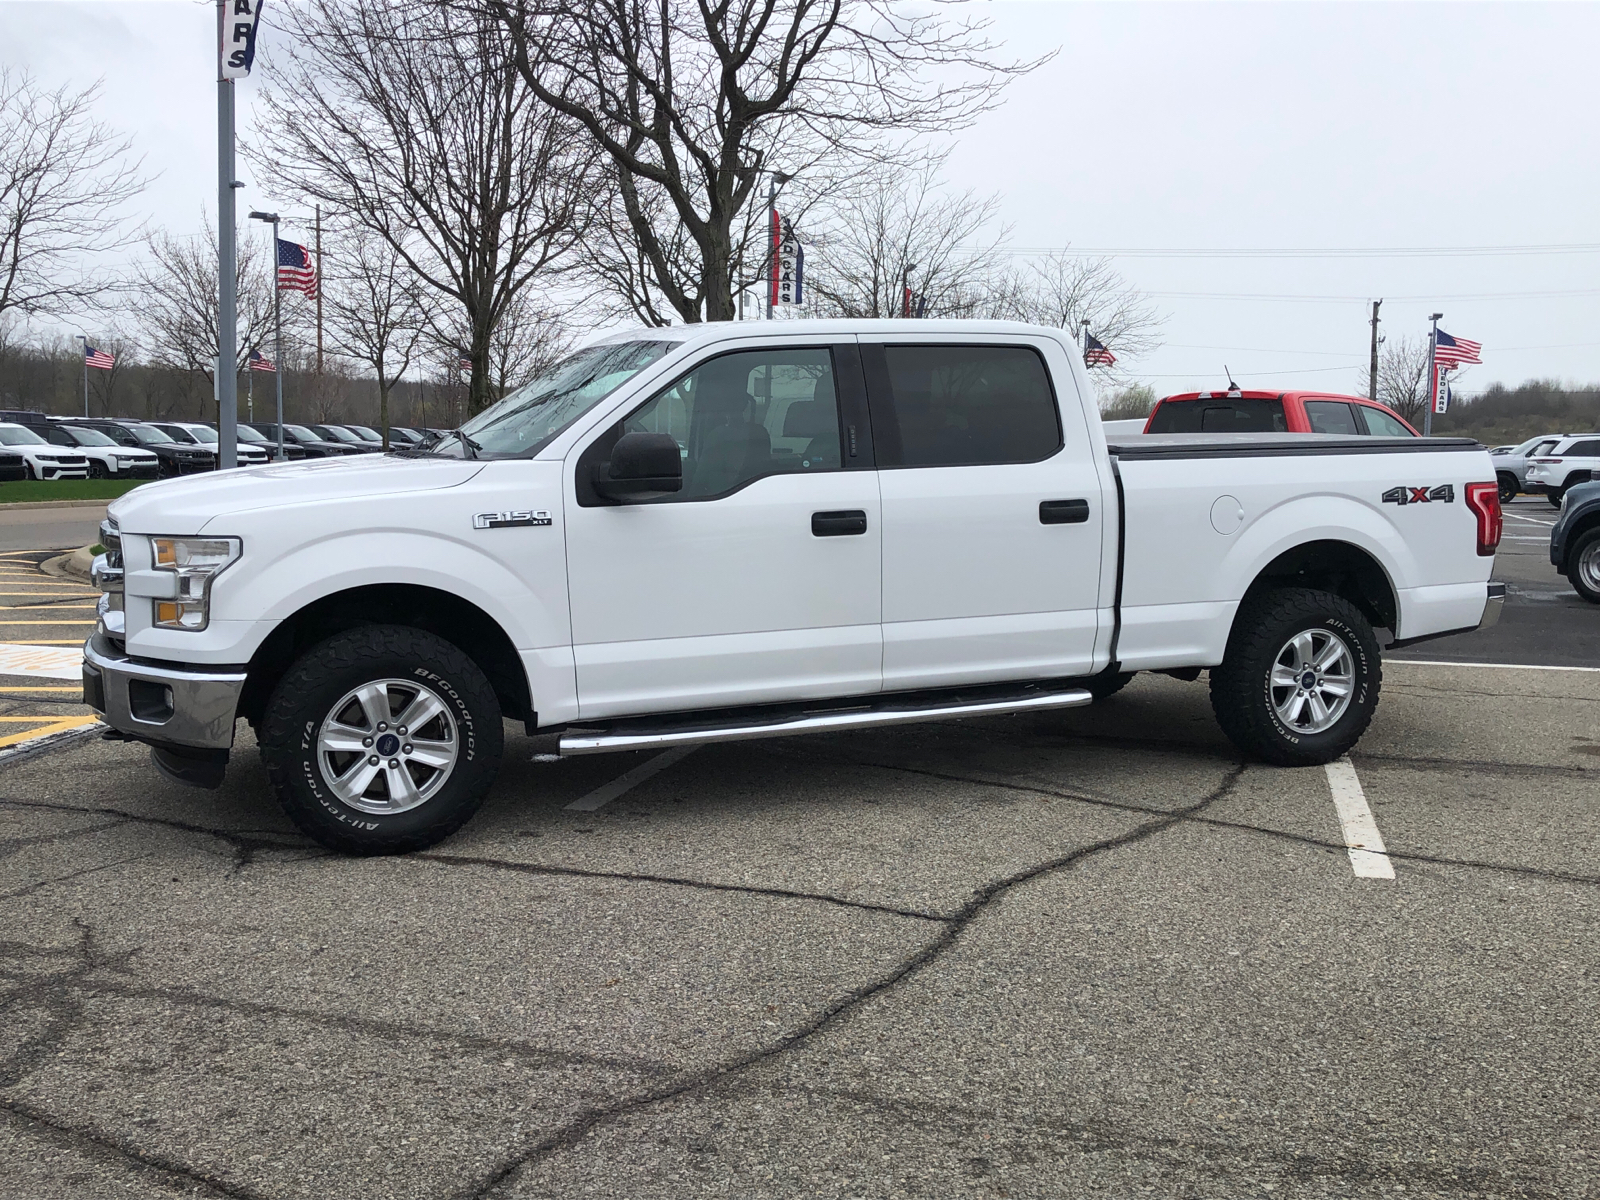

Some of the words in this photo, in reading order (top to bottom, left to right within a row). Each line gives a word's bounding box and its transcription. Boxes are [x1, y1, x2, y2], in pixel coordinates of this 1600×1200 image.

[781, 260, 791, 303] CARS
[1438, 389, 1446, 412] CARS
[1326, 618, 1368, 675] All-Terrain
[1358, 682, 1368, 704] T/A
[301, 721, 315, 750] T/A
[414, 667, 475, 761] BFGoodrich
[303, 761, 380, 831] All-Terrain
